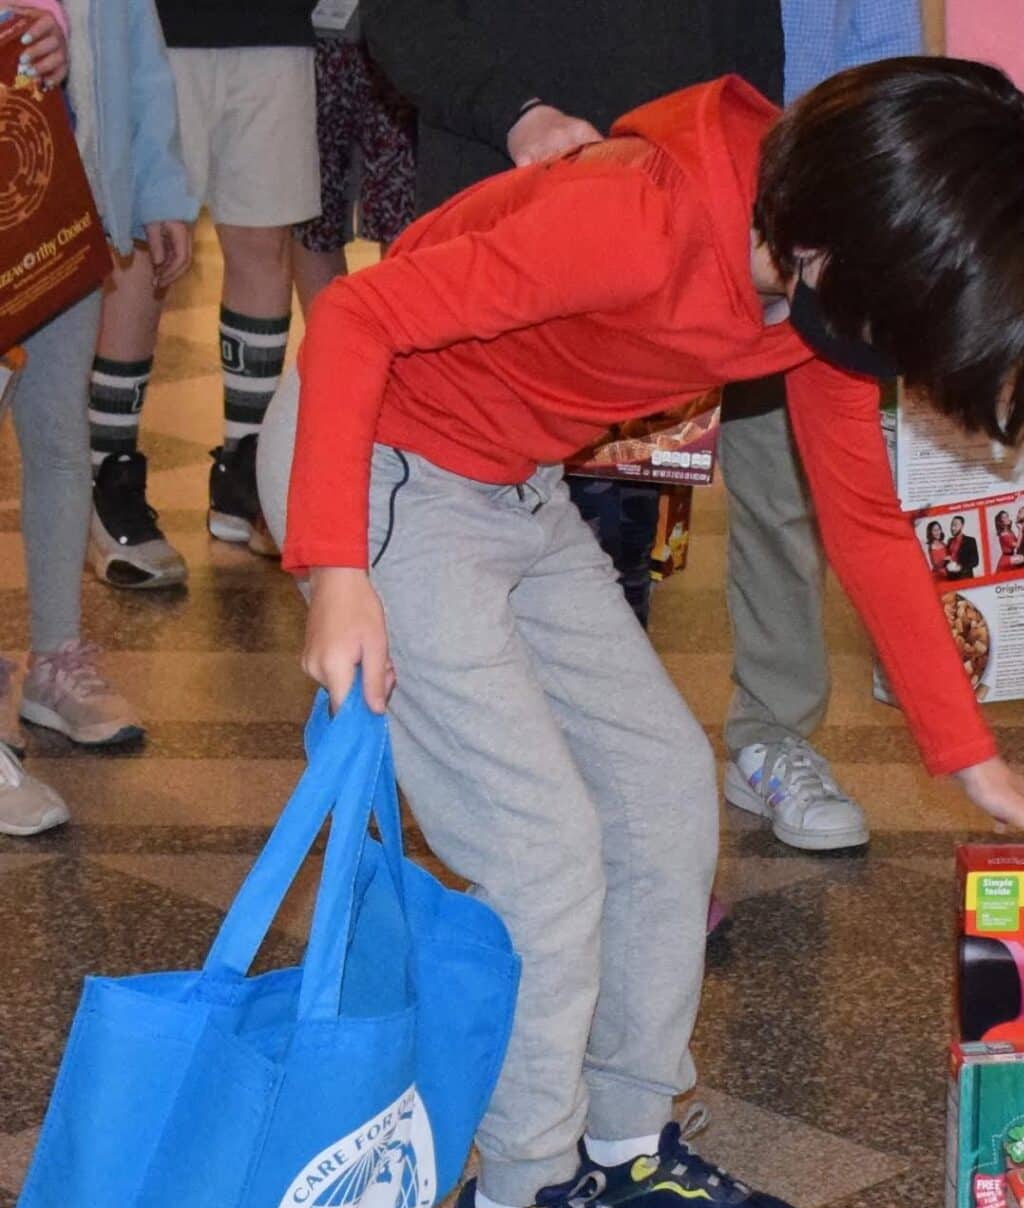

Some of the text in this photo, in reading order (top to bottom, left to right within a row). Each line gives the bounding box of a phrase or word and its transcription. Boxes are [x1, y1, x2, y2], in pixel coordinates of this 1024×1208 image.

[293, 1113, 394, 1204] CARE FOR
[977, 1179, 1002, 1191] FREE
